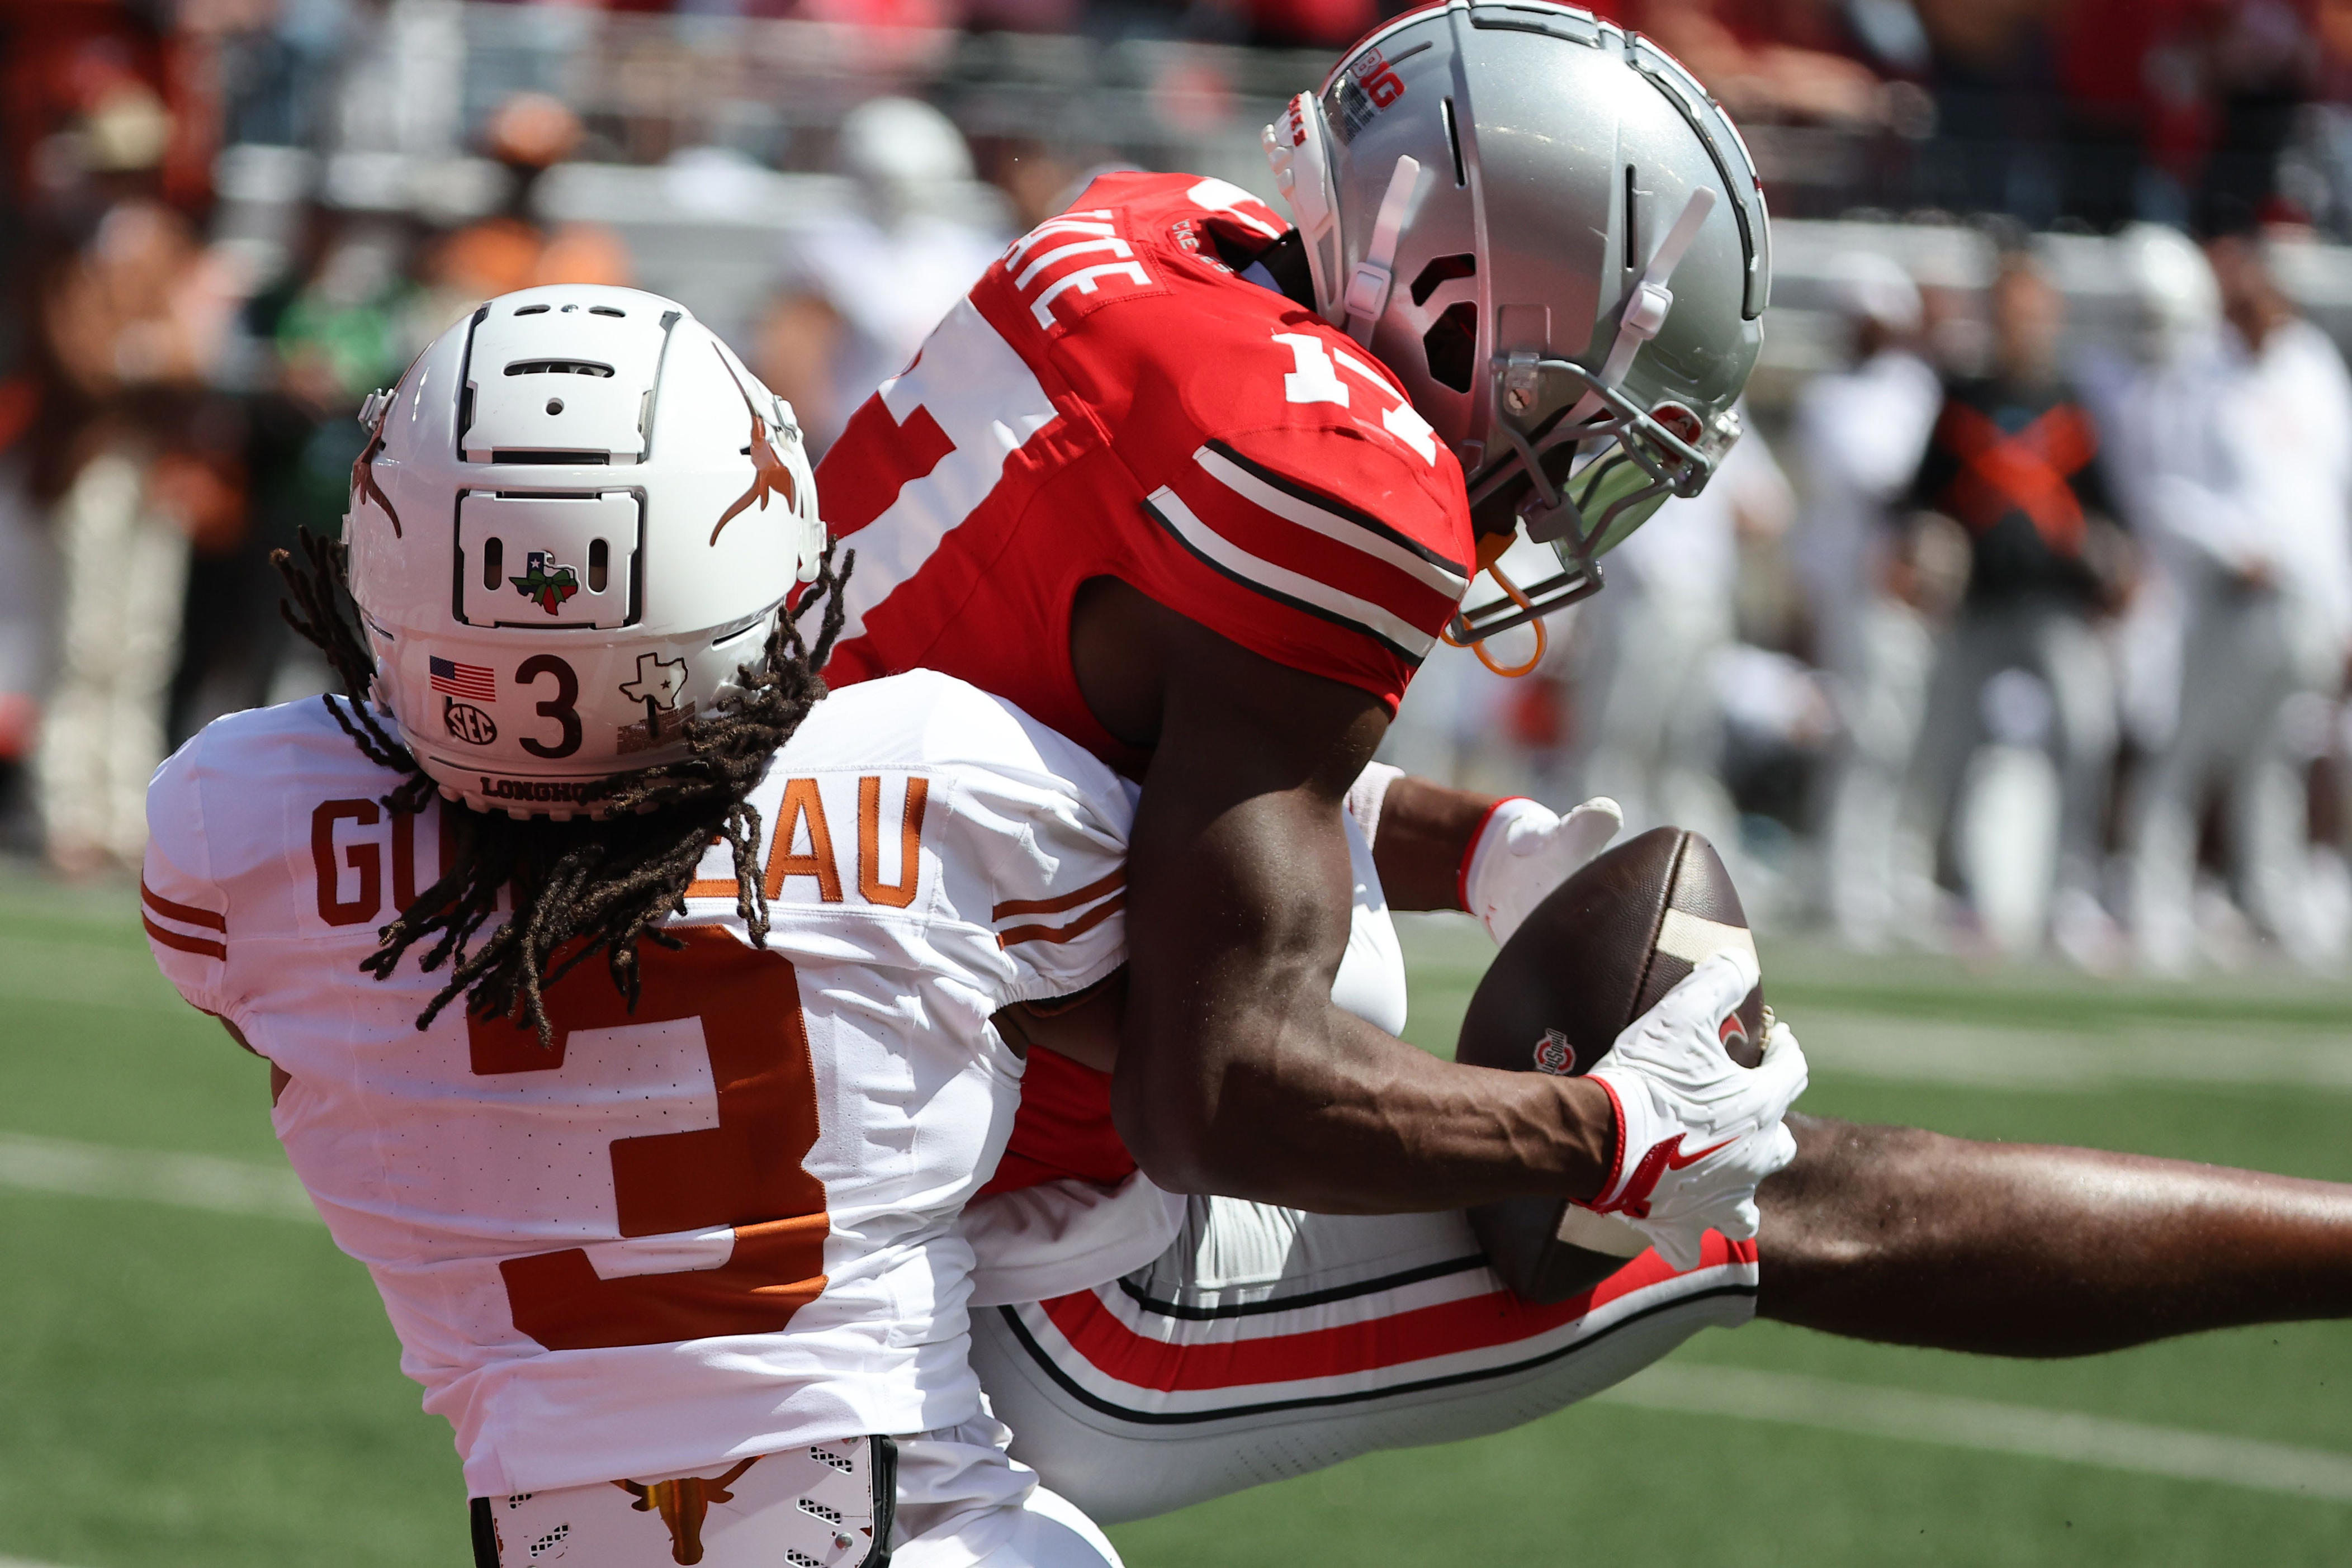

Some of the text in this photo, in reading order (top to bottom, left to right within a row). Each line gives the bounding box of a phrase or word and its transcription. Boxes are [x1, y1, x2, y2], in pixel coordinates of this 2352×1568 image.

[1271, 332, 1436, 468] 17
[447, 705, 493, 743] SEC
[515, 654, 582, 759] 3
[467, 920, 830, 1352] 3
